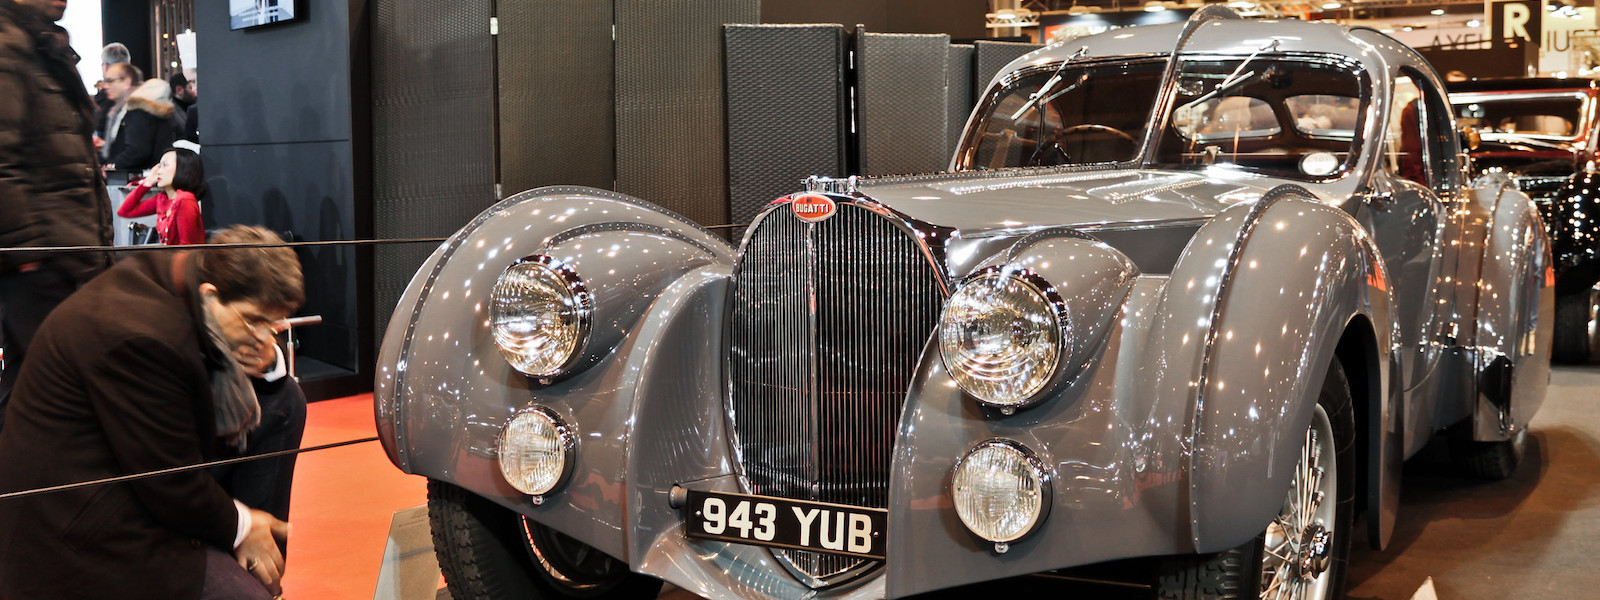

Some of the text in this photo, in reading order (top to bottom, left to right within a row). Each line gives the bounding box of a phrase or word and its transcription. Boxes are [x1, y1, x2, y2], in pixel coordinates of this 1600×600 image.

[1503, 3, 1531, 42] R
[796, 203, 829, 213] BUGATTI
[702, 497, 872, 554] 943 YUB
